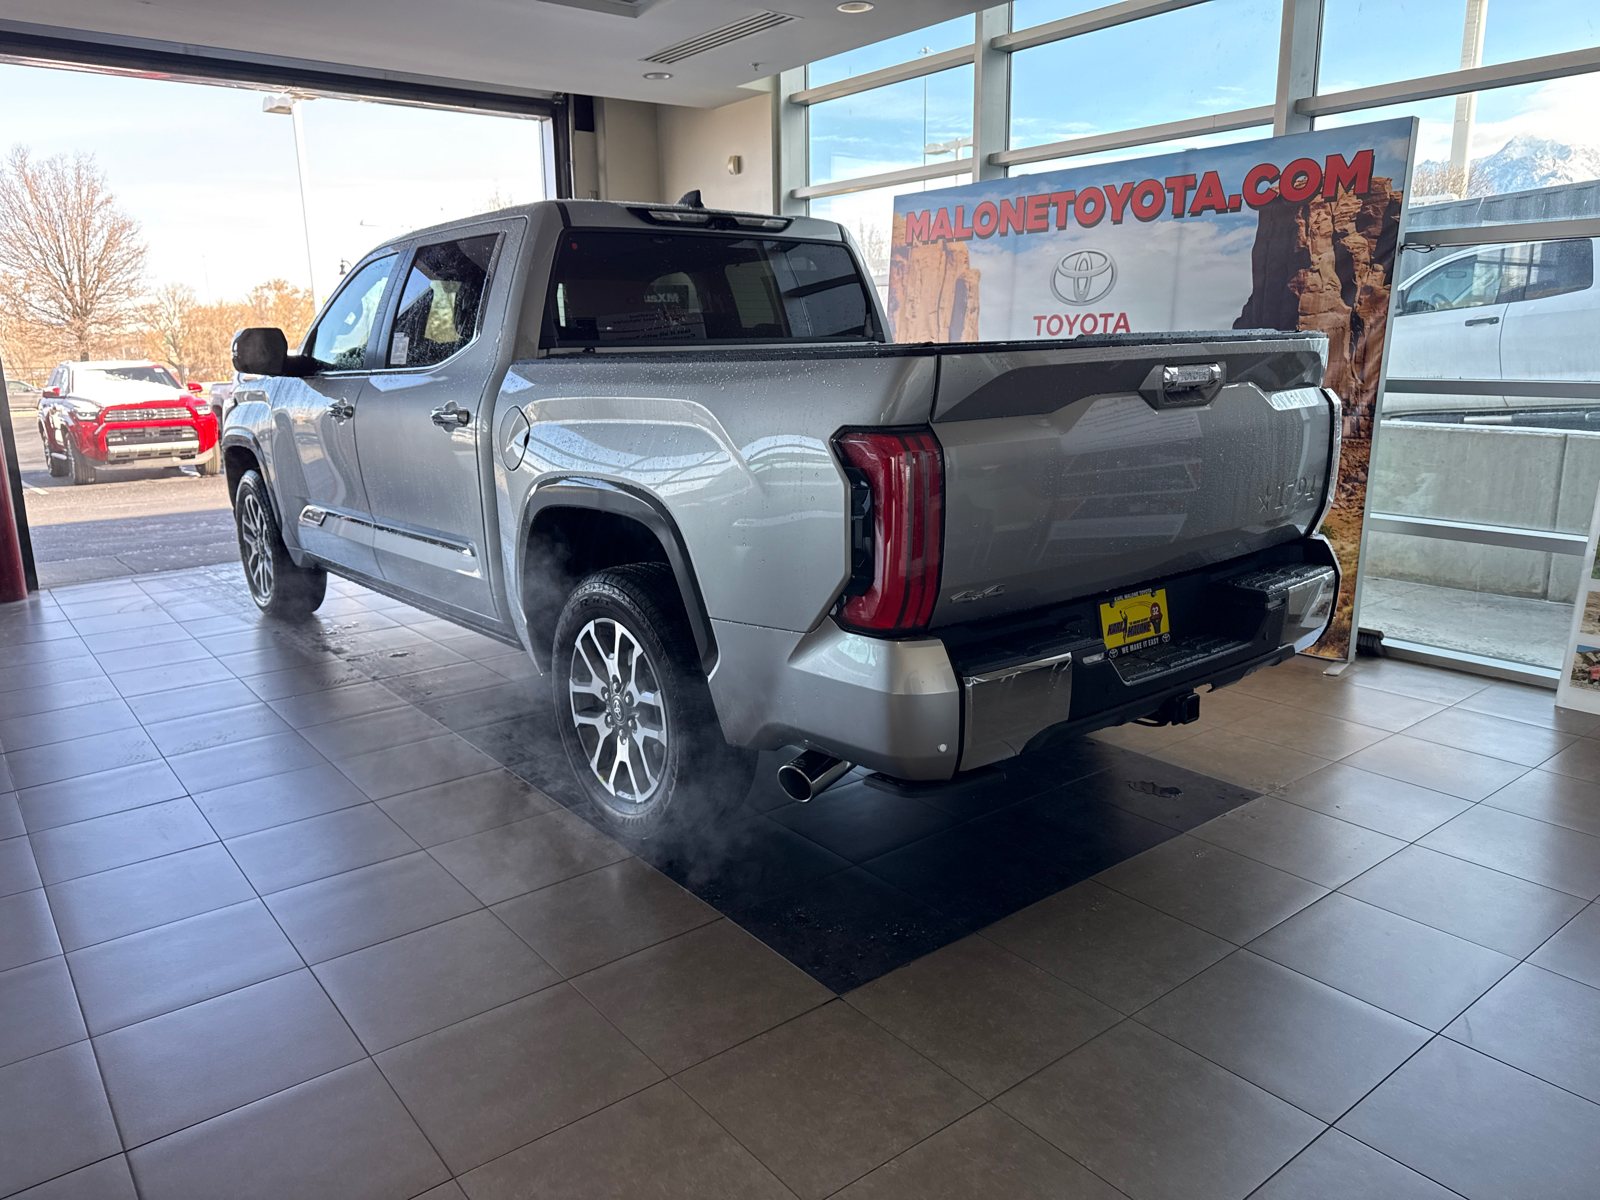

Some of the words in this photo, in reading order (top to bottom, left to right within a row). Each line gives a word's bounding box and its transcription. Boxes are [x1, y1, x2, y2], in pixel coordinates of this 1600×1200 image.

[905, 149, 1374, 244] MALONETOYOTA.COM
[1033, 312, 1131, 336] TOYOTA
[1152, 606, 1159, 615] 32
[1130, 643, 1142, 652] MAKE
[1143, 641, 1148, 649] IT
[1148, 638, 1159, 646] EASY
